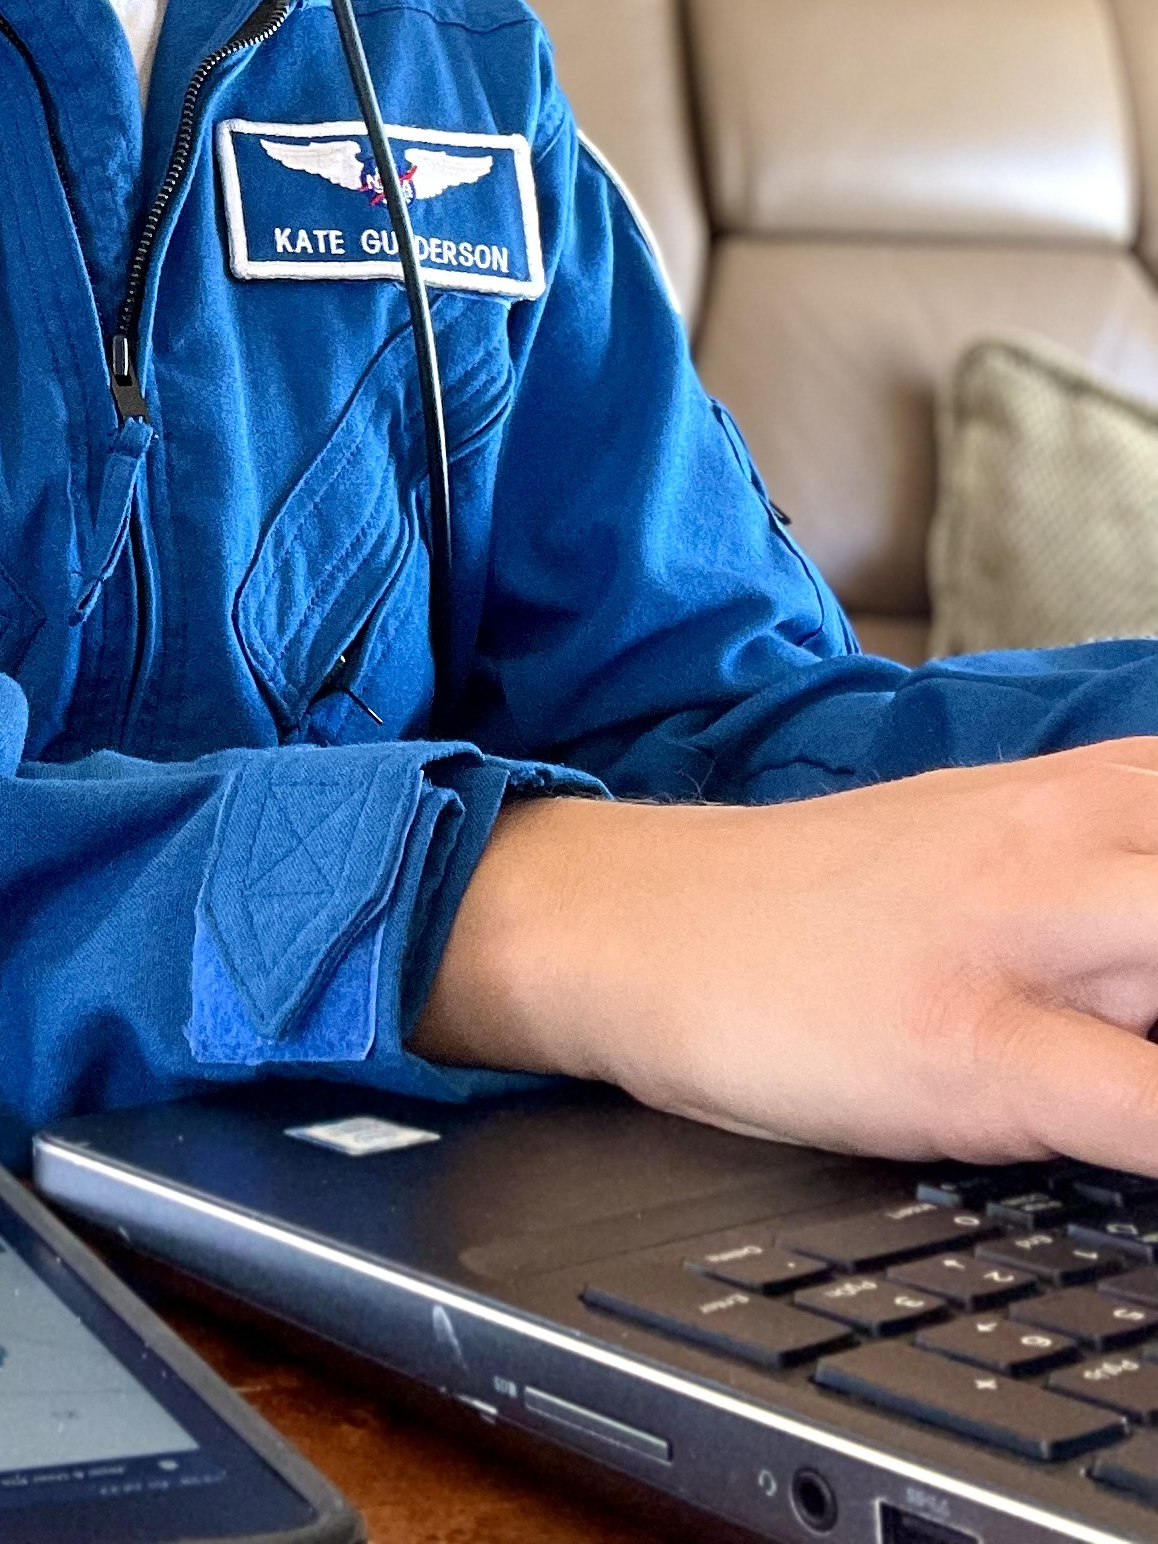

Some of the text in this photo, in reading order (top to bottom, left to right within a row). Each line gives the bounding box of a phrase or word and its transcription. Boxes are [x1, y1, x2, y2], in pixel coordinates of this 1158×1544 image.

[274, 227, 509, 273] KATE GUDERSON
[1014, 1234, 1053, 1250] End
[983, 1270, 1015, 1283] 2
[699, 1293, 750, 1314] Enter
